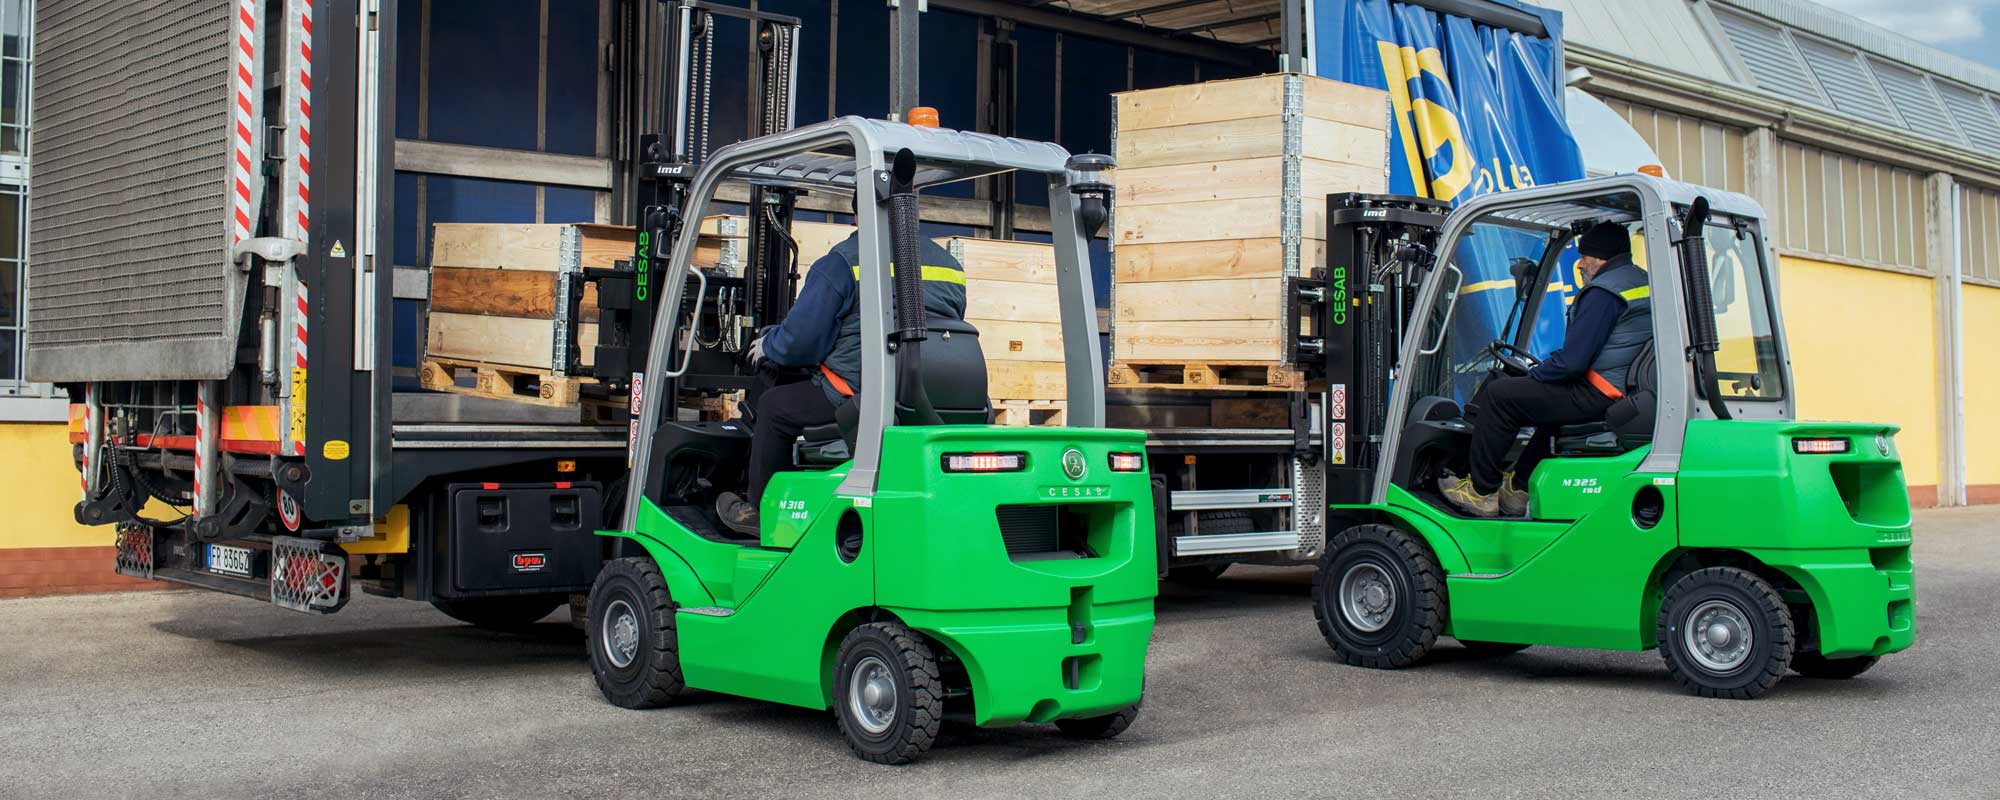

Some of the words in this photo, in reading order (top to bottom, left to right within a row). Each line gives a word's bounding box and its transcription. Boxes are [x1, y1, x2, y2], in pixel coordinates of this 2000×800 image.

[636, 231, 650, 301] CESAB
[1333, 266, 1346, 324] CESAB
[1048, 487, 1103, 497] CESAB
[1563, 479, 1572, 487] M
[1573, 478, 1597, 487] 325
[282, 495, 294, 516] 80
[787, 500, 805, 510] 318
[212, 546, 221, 562] FR
[223, 548, 249, 572] 836GZ
